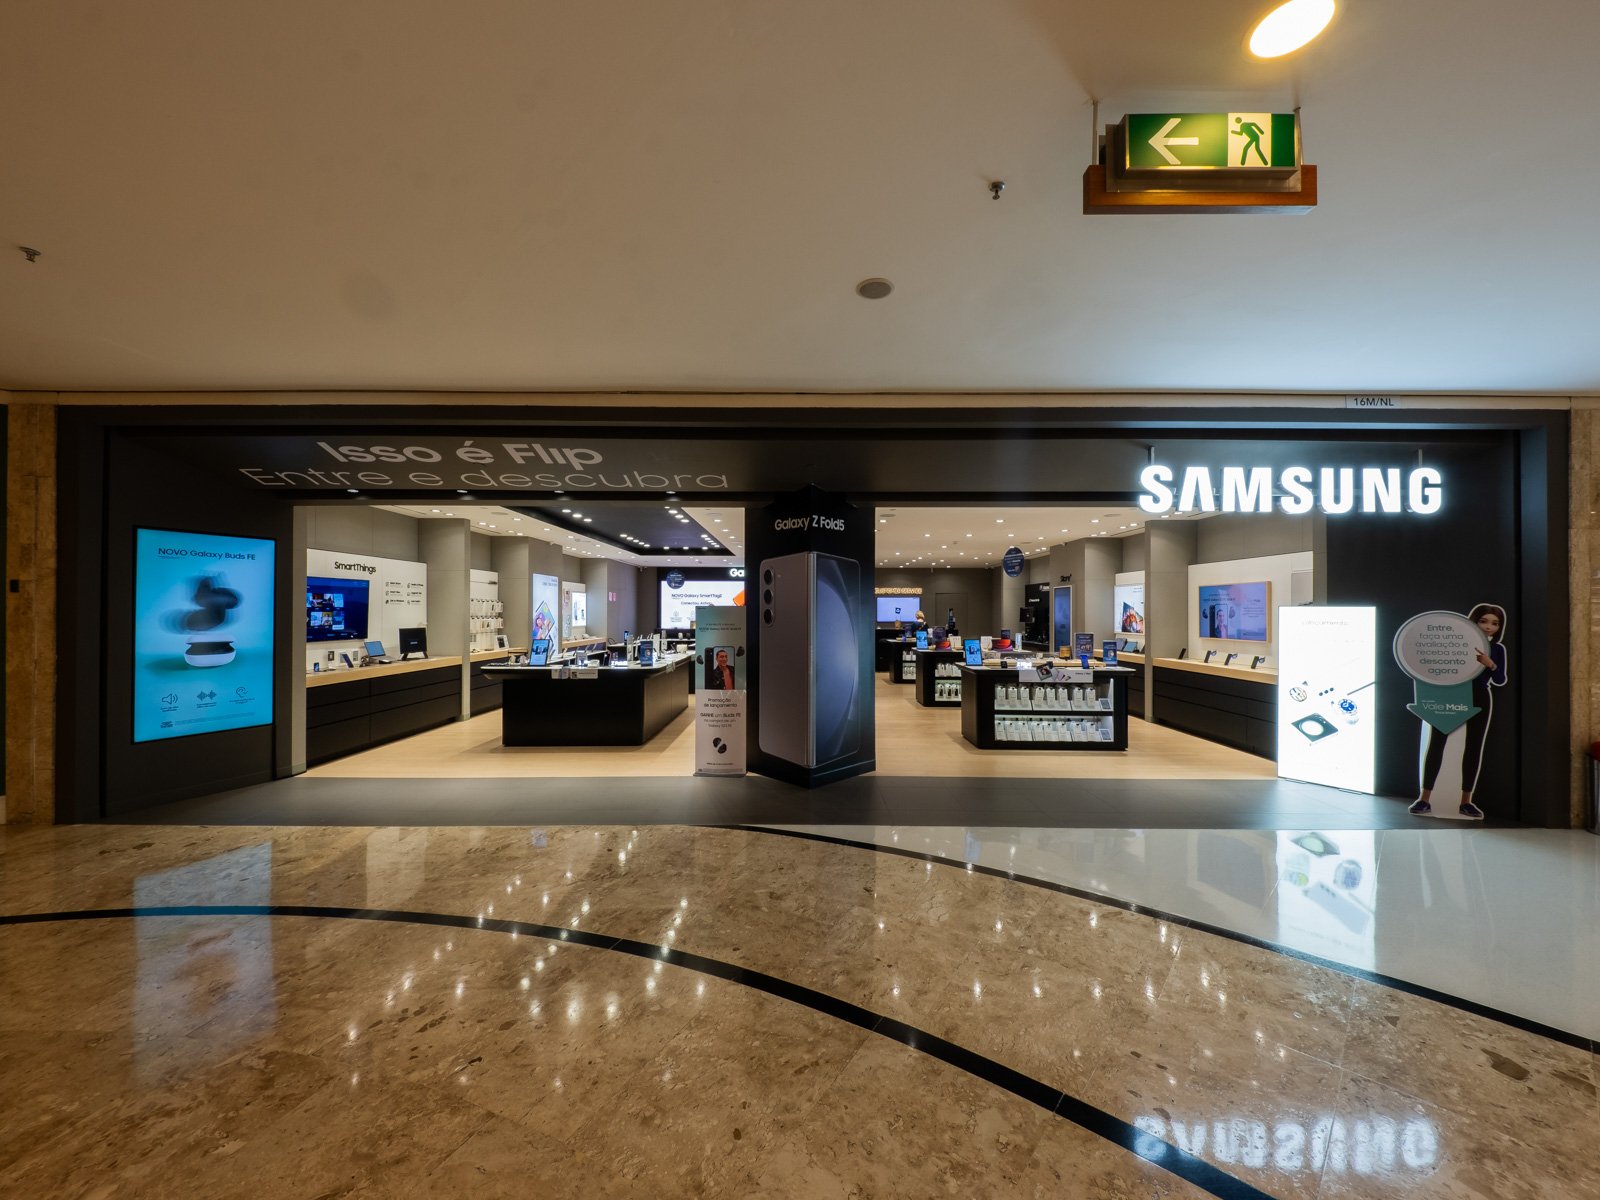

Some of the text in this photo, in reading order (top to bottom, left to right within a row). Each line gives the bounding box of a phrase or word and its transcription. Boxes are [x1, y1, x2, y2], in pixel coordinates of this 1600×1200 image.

[1353, 397, 1395, 407] 16M/NL
[316, 440, 603, 471] Isso é Flip
[238, 468, 729, 489] Entre e descubra
[1138, 464, 1443, 515] SAMSUNG
[774, 514, 845, 531] Galaxy Z Fold5
[157, 547, 188, 556] NOVO
[189, 550, 223, 560] Galaxy
[224, 552, 246, 560] Buds
[246, 553, 256, 561] FE
[334, 561, 377, 575] SmartThings
[1427, 624, 1455, 633] Entre,
[1415, 641, 1461, 649] avaliação
[1427, 668, 1459, 676] agora
[1446, 703, 1469, 711] Mais
